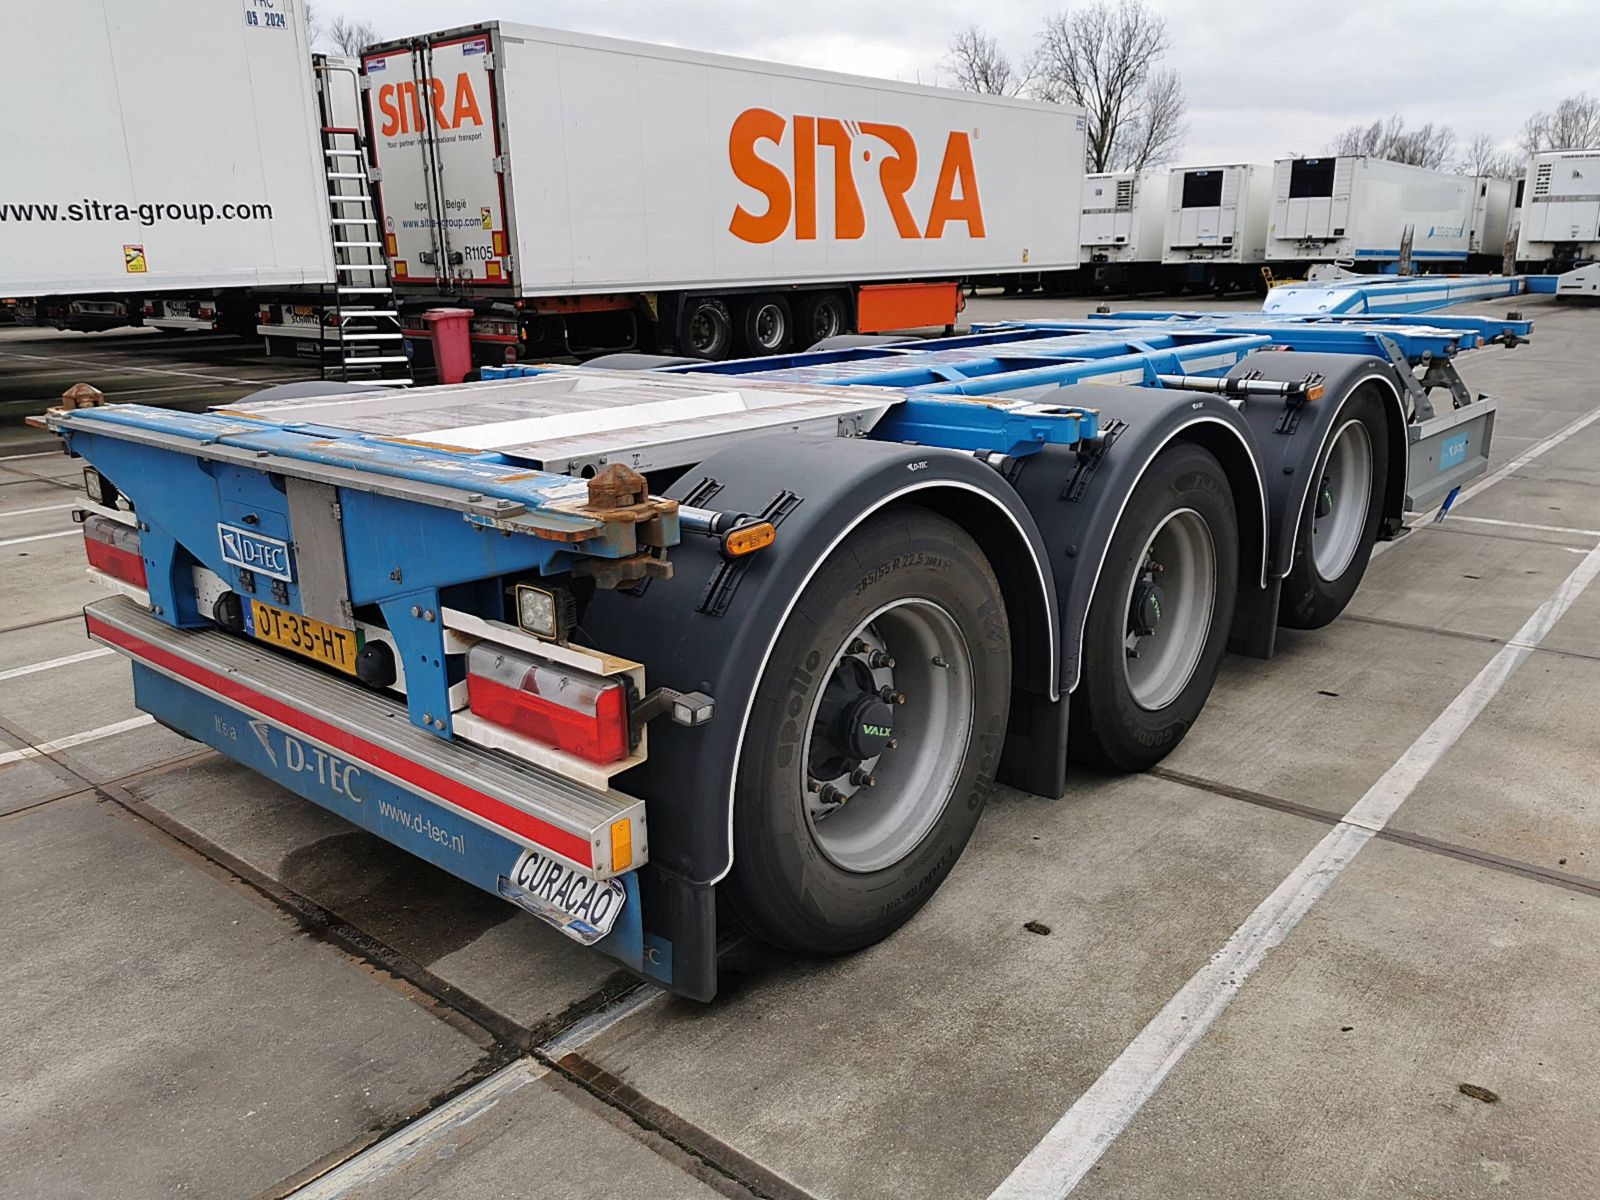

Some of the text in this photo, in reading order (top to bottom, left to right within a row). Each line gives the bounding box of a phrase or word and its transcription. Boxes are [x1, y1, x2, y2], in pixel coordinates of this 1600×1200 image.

[247, 11, 285, 27] 05 2024
[379, 72, 483, 137] SITRA
[458, 132, 482, 141] transport
[729, 108, 986, 243] SITRA
[414, 201, 430, 212] Iepe
[402, 217, 482, 231] www.sita-group.com
[465, 246, 493, 260] R1105
[243, 539, 284, 571] D-TEC
[854, 562, 891, 596] 385/55
[902, 553, 924, 568] 22.5
[259, 605, 346, 665] OT-35-HT
[776, 650, 821, 769] apollo
[214, 715, 238, 741] It's a
[863, 724, 891, 736] VALX
[285, 735, 362, 803] D-TEC
[378, 799, 465, 855] www.d-tec.nl
